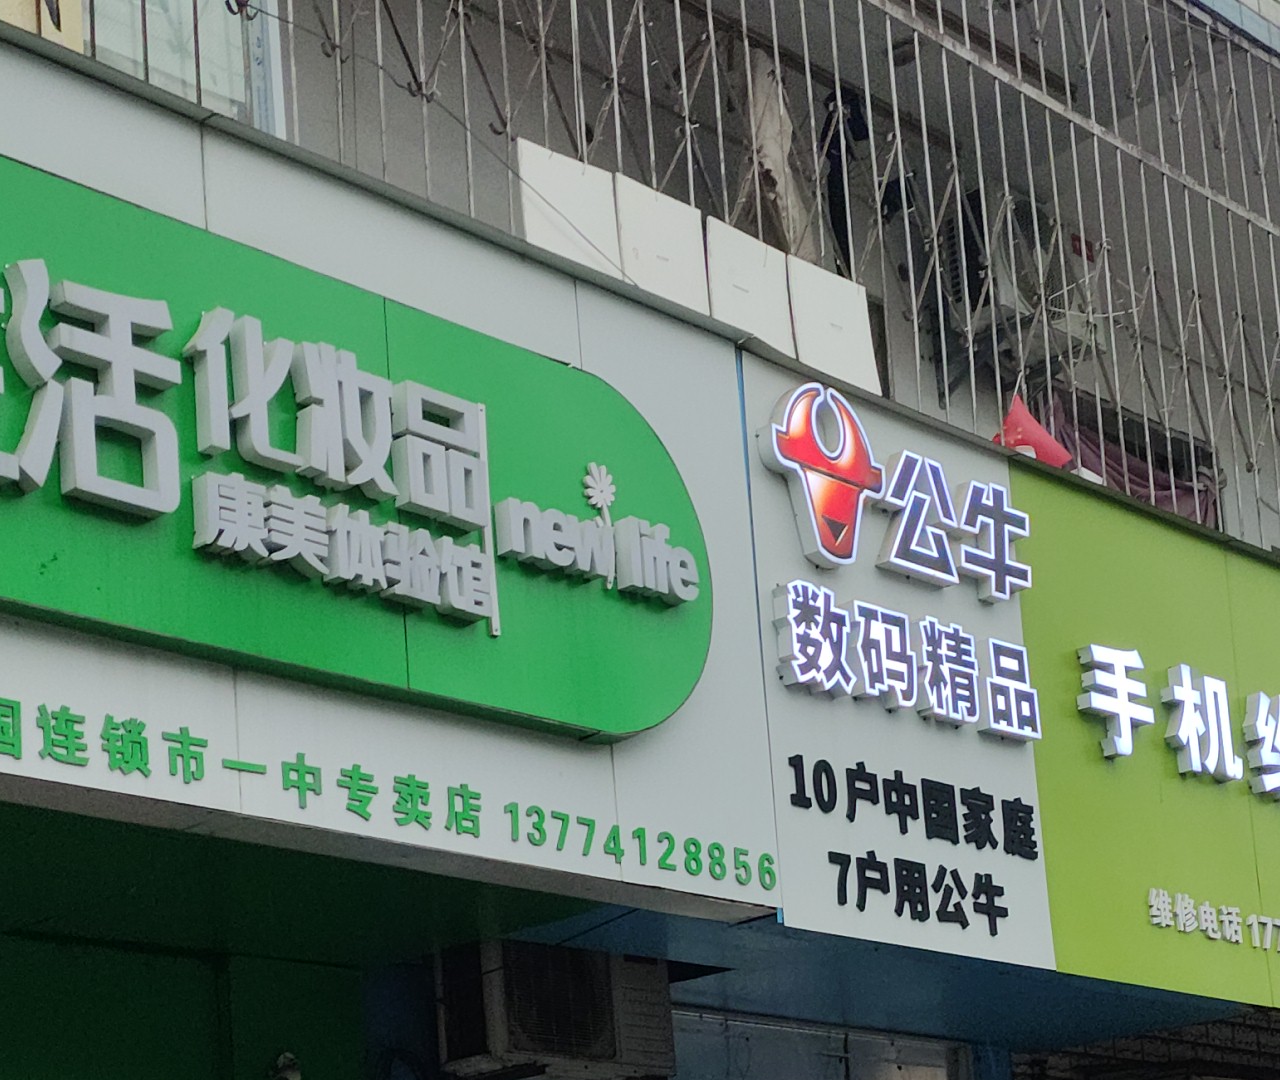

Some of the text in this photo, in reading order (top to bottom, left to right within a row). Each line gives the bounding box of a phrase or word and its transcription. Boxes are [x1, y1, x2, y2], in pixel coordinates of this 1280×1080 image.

[183, 305, 487, 532] 化妆品
[192, 471, 490, 626] 康美体验馆
[873, 448, 1032, 602] 公牛
[777, 580, 1042, 741] 数码精品
[503, 800, 777, 892] 13774128856
[788, 753, 1039, 861] 10户中国家庭
[828, 850, 1009, 937] 7户用公牛
[1148, 887, 1243, 945] 维修电话
